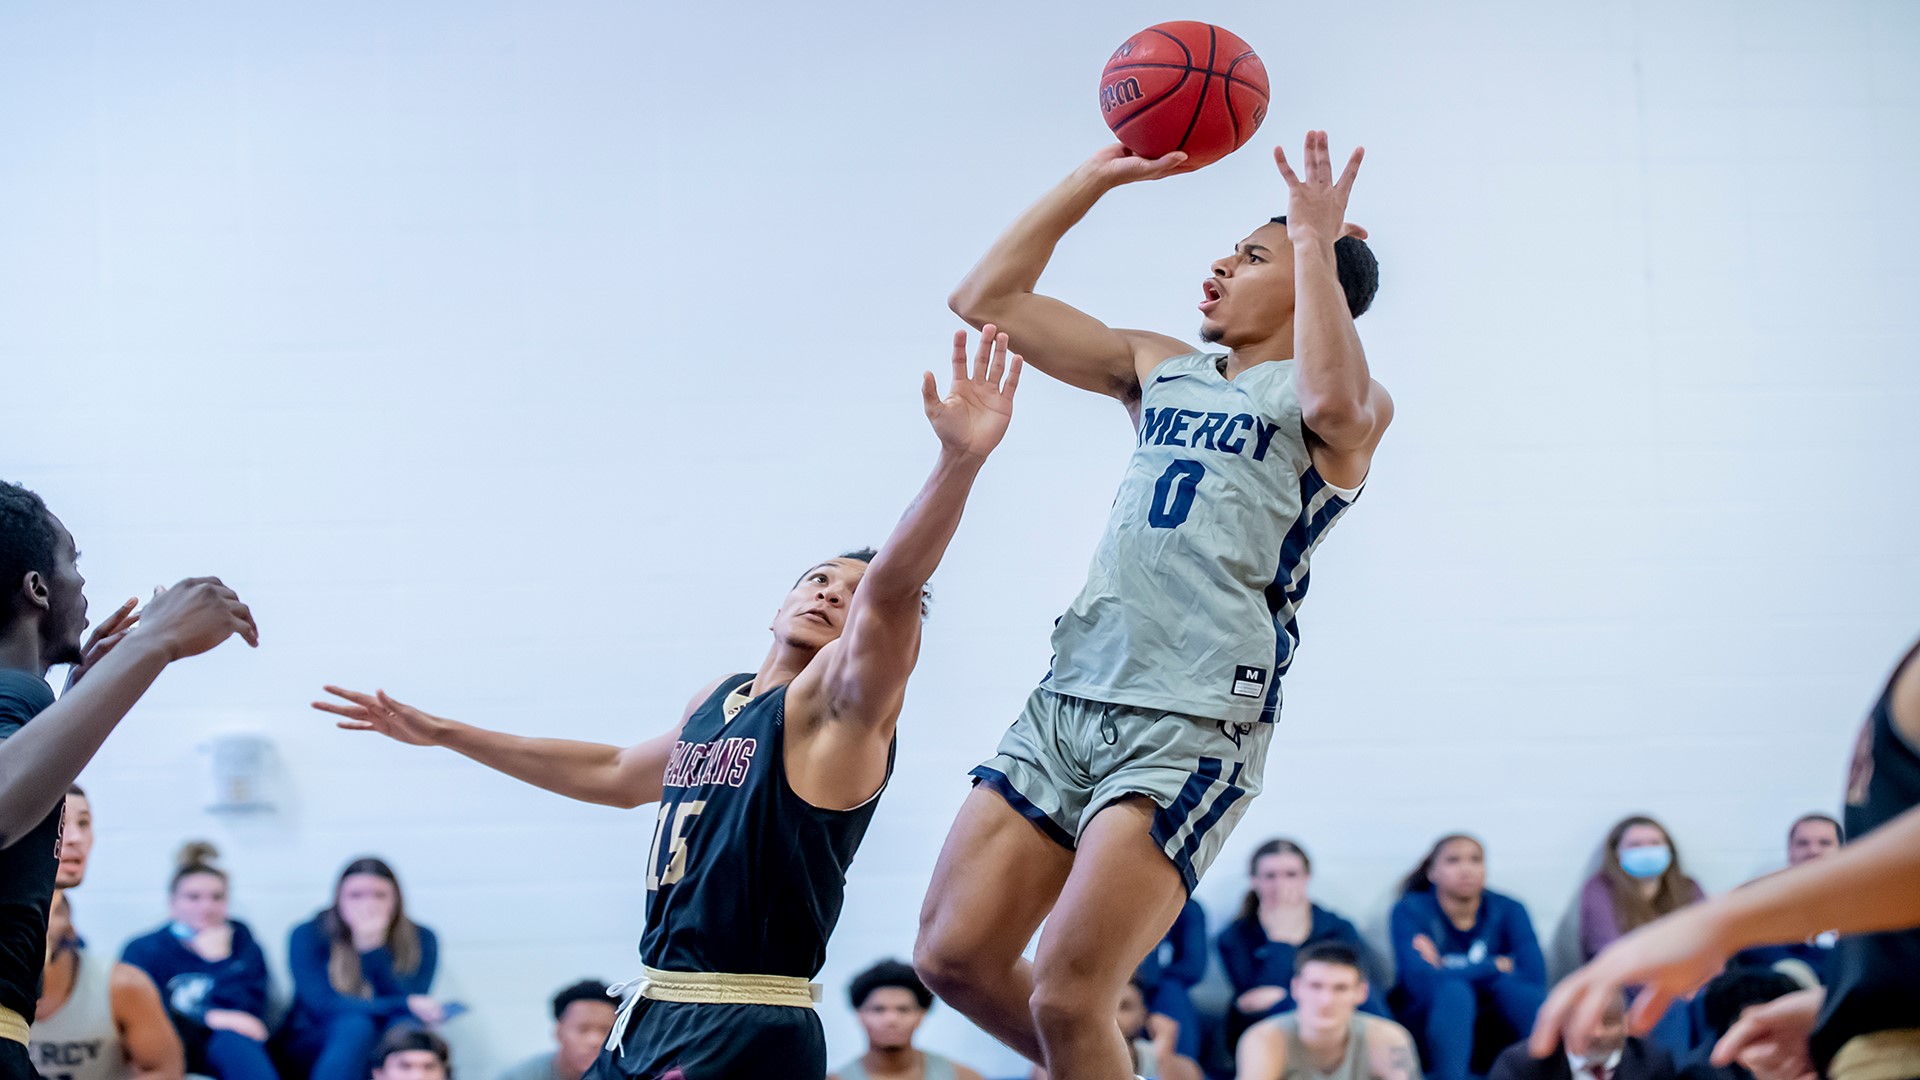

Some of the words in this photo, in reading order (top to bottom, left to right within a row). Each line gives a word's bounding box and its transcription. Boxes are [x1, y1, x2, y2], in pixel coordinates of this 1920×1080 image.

[1139, 407, 1281, 462] MERCY
[1148, 459, 1206, 529] 0
[1246, 669, 1259, 680] M
[663, 737, 757, 788] PARTANS
[646, 800, 707, 890] 15
[30, 1038, 103, 1066] RCY
